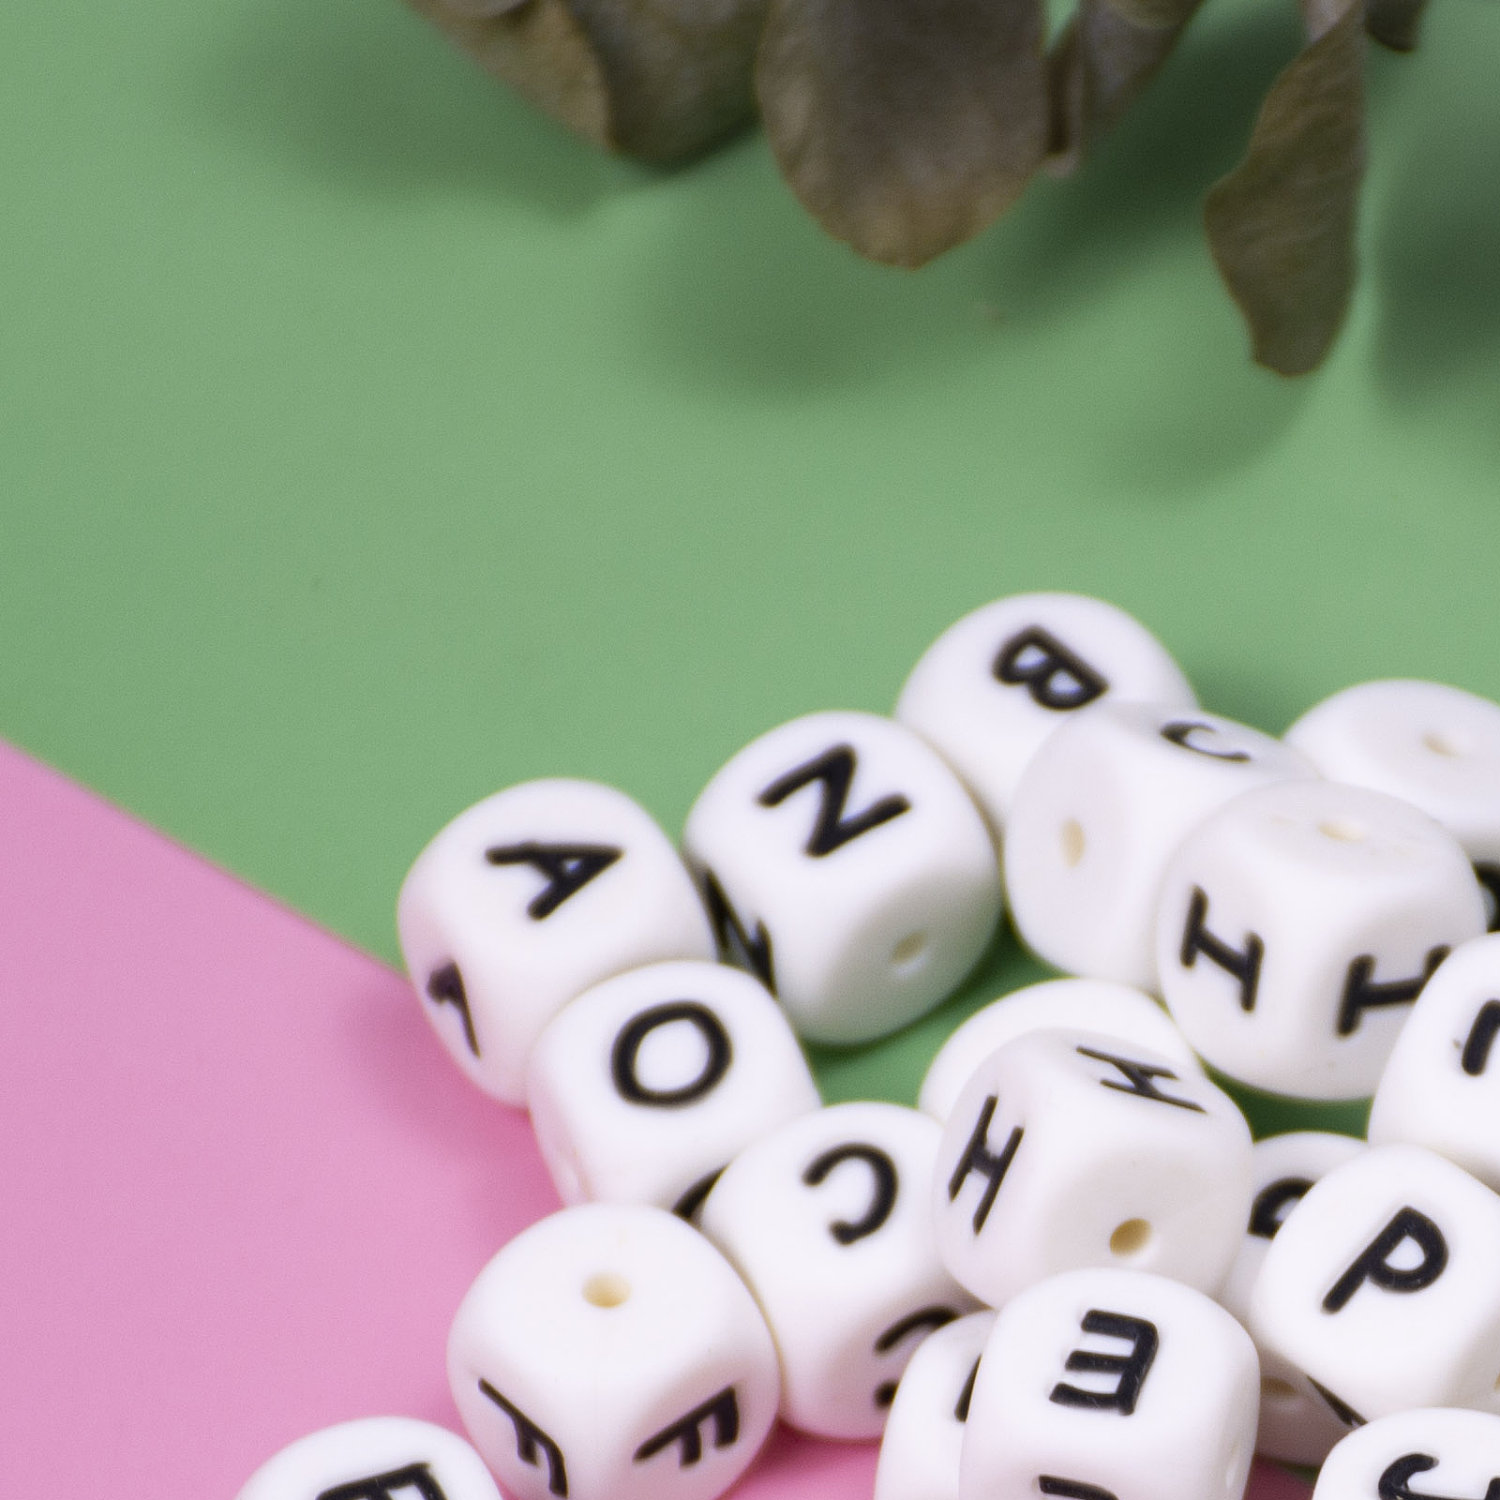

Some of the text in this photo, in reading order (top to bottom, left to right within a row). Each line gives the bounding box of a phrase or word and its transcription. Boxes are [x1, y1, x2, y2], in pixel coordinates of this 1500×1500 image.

[994, 629, 1107, 712] B
[488, 843, 621, 920] A
[611, 1002, 732, 1107] O
[803, 1144, 898, 1245] C
[950, 1096, 1024, 1233] H
[1323, 1207, 1448, 1313] P
[1049, 1309, 1159, 1416] E
[480, 1379, 570, 1500] F
[634, 1385, 741, 1467] F
